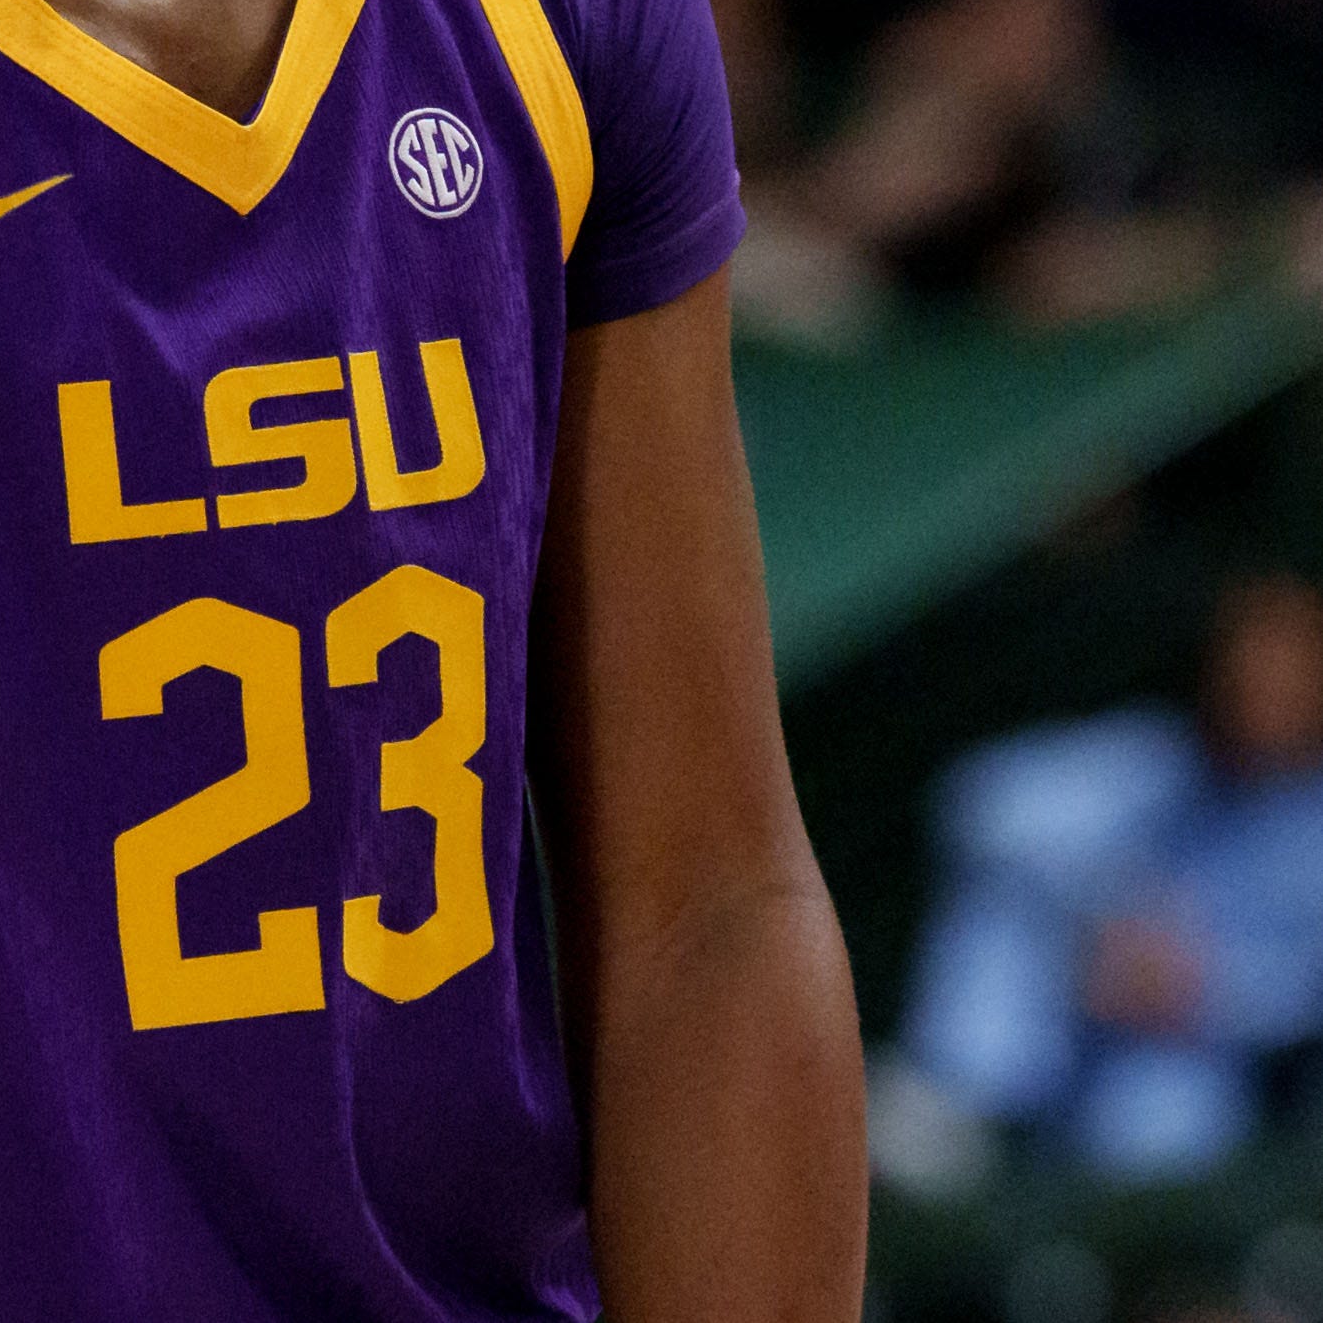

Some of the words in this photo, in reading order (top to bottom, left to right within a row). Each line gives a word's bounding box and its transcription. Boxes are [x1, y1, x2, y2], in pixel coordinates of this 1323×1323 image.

[397, 118, 475, 207] SEC
[57, 338, 486, 545] LSU
[98, 564, 494, 1031] 23
